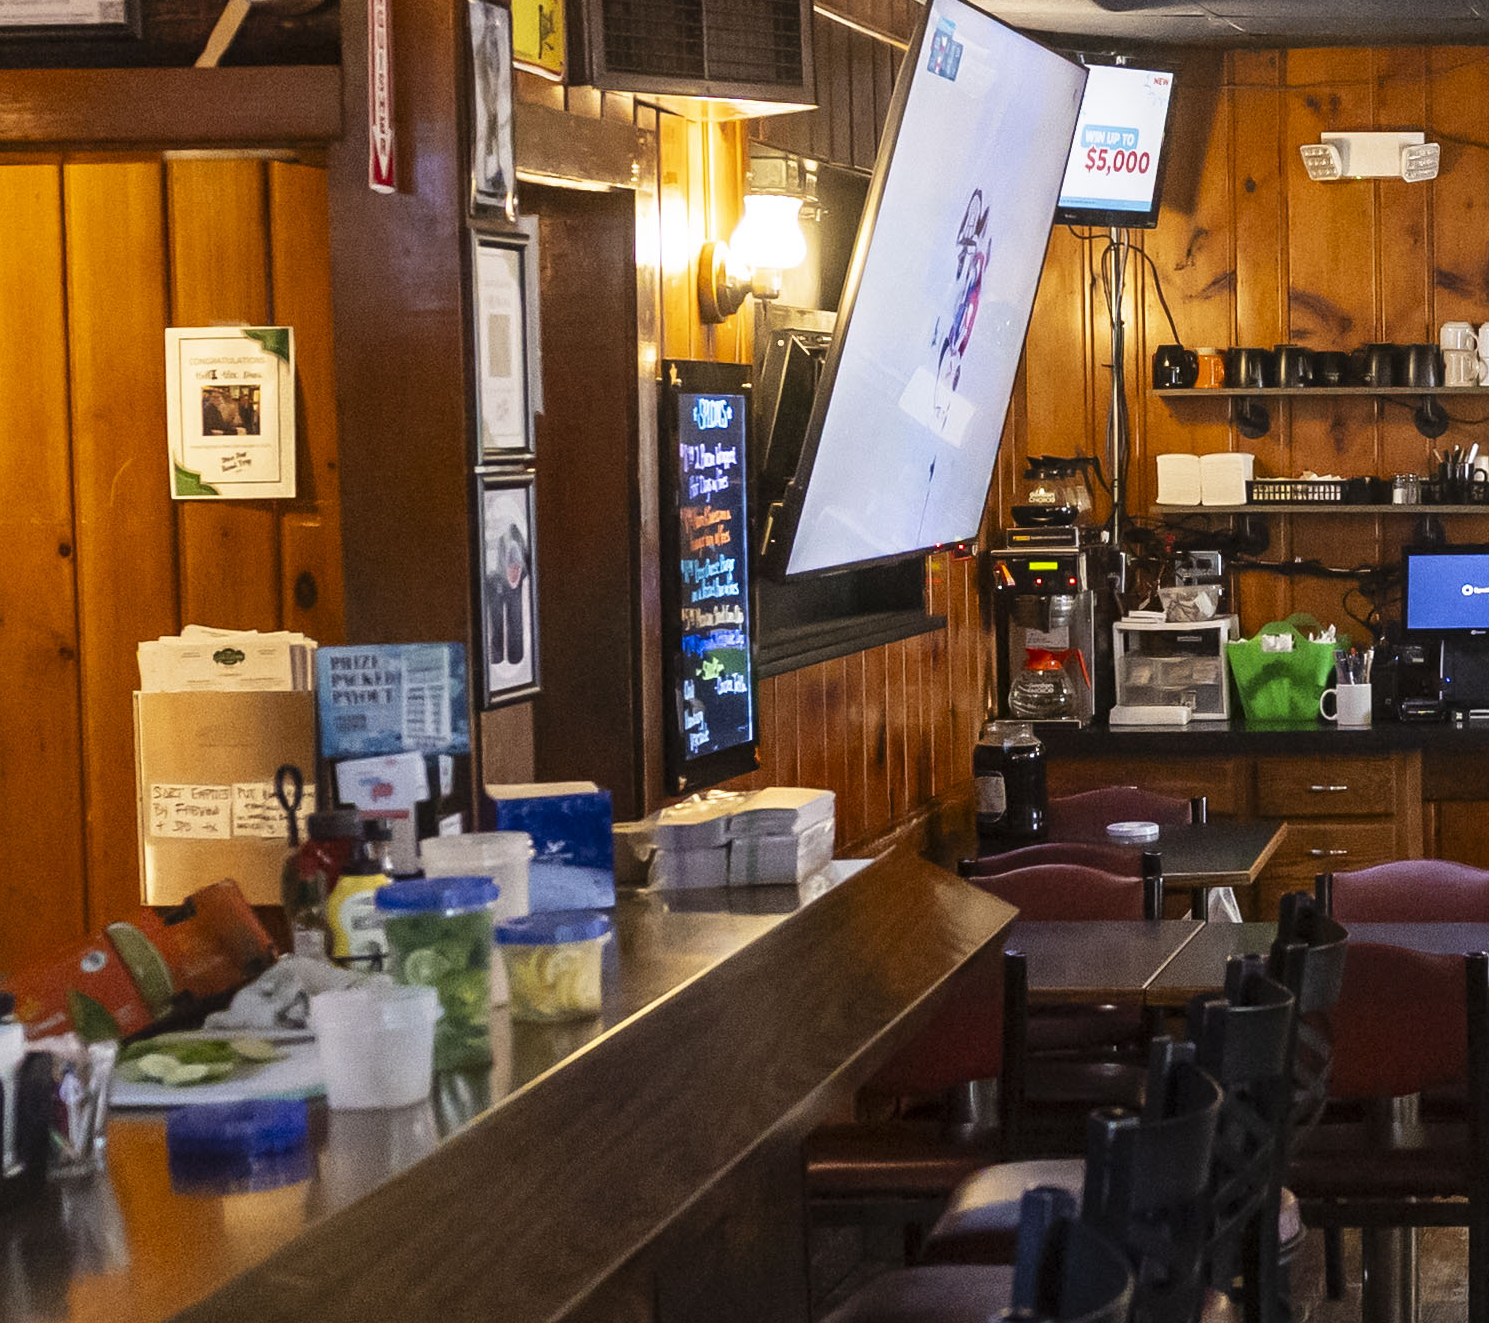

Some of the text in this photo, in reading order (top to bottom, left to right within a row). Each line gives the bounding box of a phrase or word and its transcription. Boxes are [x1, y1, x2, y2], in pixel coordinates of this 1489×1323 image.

[1085, 129, 1135, 146] WIN UP TO
[1085, 145, 1150, 176] $5,000
